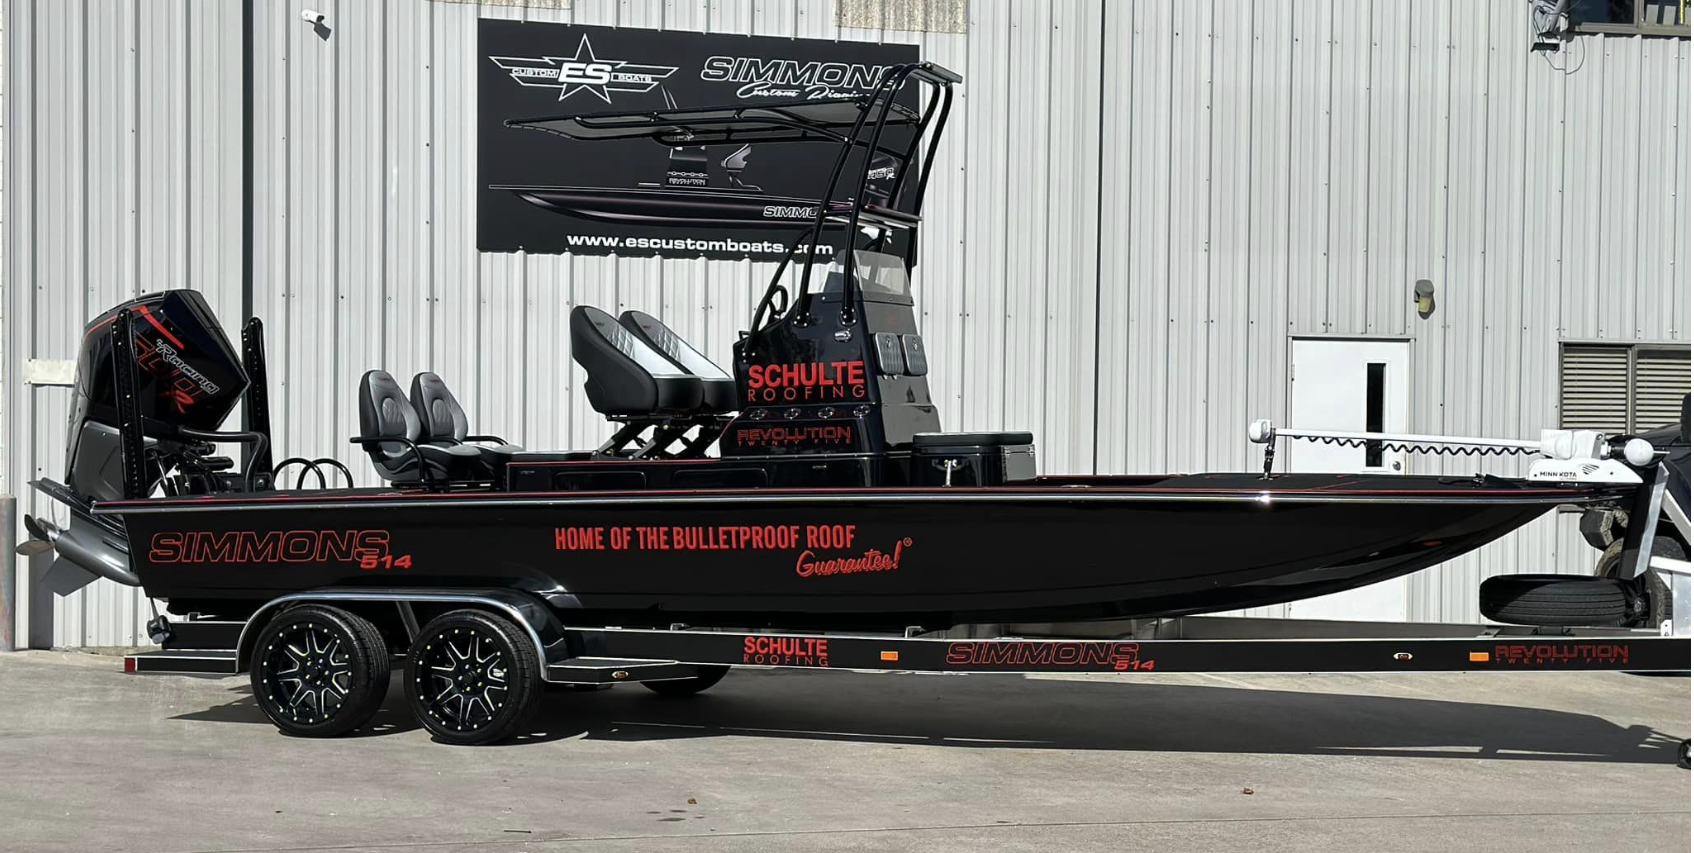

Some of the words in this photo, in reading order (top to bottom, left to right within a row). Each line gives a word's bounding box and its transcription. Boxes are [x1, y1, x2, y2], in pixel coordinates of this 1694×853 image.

[511, 68, 556, 79] CUSTOM
[557, 62, 613, 85] ES
[618, 73, 652, 83] BOATS
[736, 81, 802, 99] Custom
[763, 205, 818, 219] SIMMO
[156, 338, 220, 394] Racing
[748, 360, 865, 389] SCHULTE
[748, 385, 865, 402] ROOFING
[737, 426, 852, 441] REVOLUTION
[554, 527, 605, 550] HOME
[610, 527, 632, 550] OF
[636, 526, 669, 550] THE
[673, 526, 800, 550] BULLETPROOF
[807, 525, 856, 549] ROOF
[149, 530, 390, 563] SIMMONS
[360, 554, 412, 570] 514
[744, 636, 829, 657] SCHULTE
[946, 641, 1140, 665] SIMMONS
[1114, 659, 1155, 671] 514
[1495, 645, 1629, 659] REVOLUTION
[743, 653, 829, 667] ROOFING
